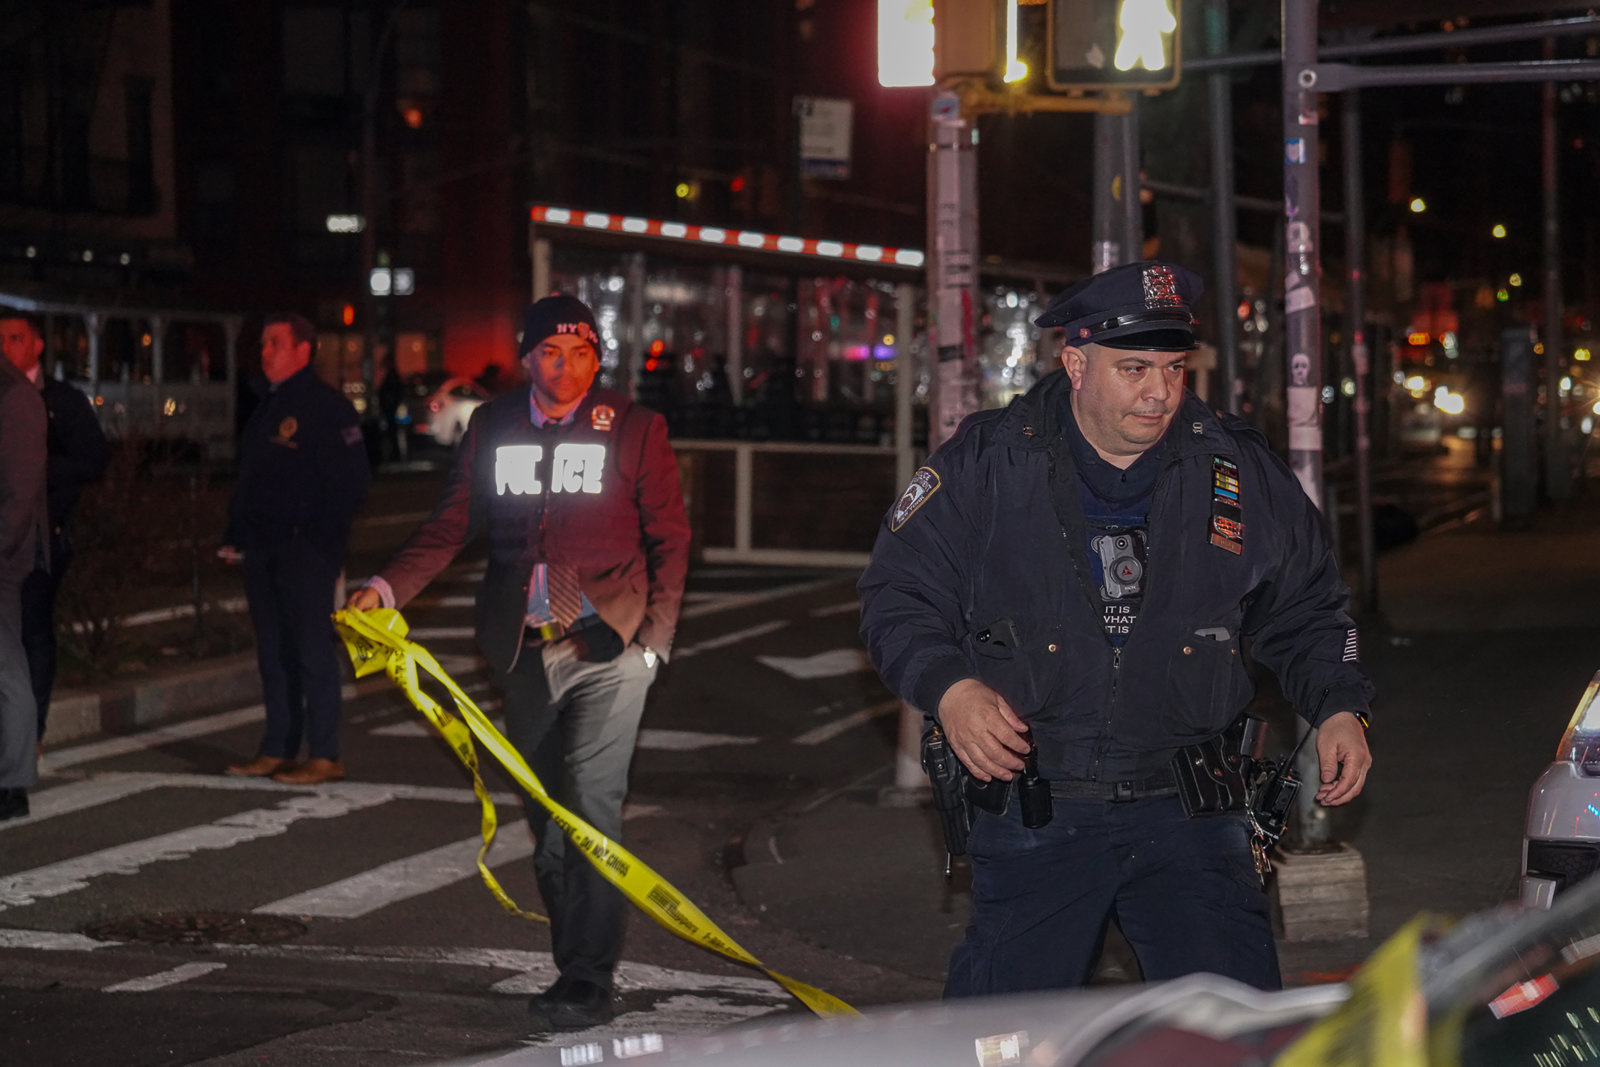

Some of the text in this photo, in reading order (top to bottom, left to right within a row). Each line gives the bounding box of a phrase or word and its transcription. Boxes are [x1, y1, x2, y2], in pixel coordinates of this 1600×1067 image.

[1105, 605, 1131, 614] IT IS
[1118, 625, 1130, 634] IS
